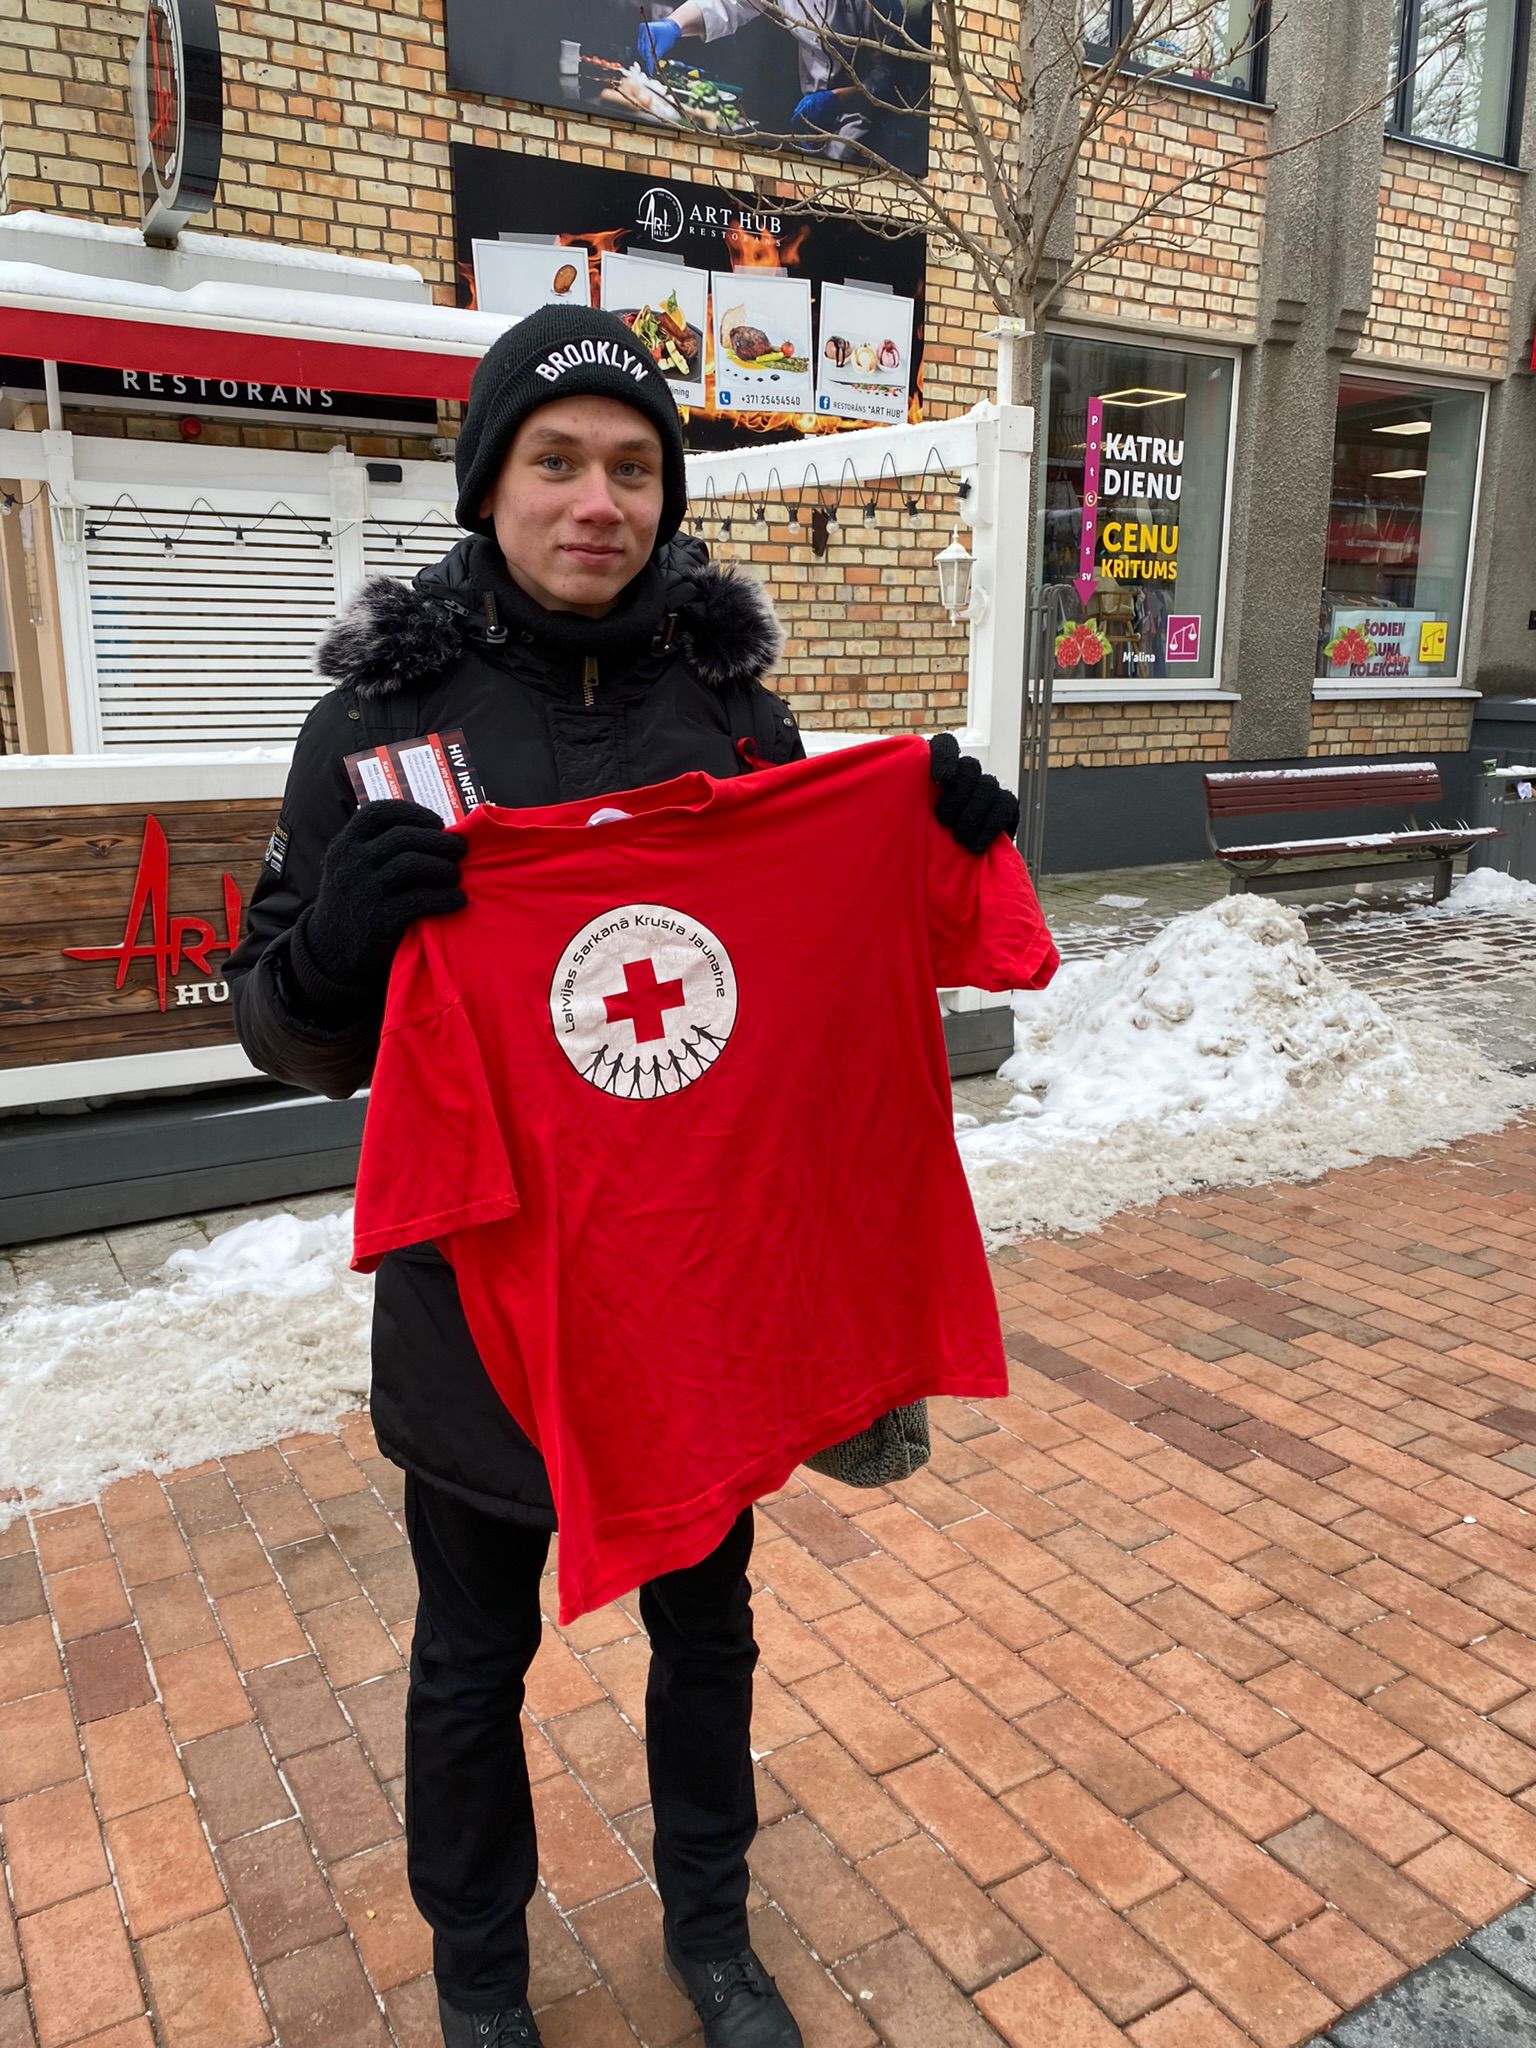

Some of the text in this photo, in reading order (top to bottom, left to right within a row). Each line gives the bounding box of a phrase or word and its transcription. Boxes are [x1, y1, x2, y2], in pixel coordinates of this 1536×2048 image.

[689, 204, 732, 226] ART
[739, 211, 781, 234] HUB
[535, 339, 649, 382] BROOKLYN
[122, 369, 334, 407] RESTORANS
[741, 394, 801, 406] +371 25454540
[1105, 432, 1184, 466] KATRU
[1103, 468, 1182, 501] DIENU
[1103, 521, 1179, 554] CENU
[1101, 558, 1178, 580] KRITUMS
[1122, 651, 1156, 663] M'alina
[447, 744, 467, 768] HIV
[560, 914, 726, 1034] Latvijas Sarkanā Krusta Jaunatne
[174, 981, 230, 1006] HU
